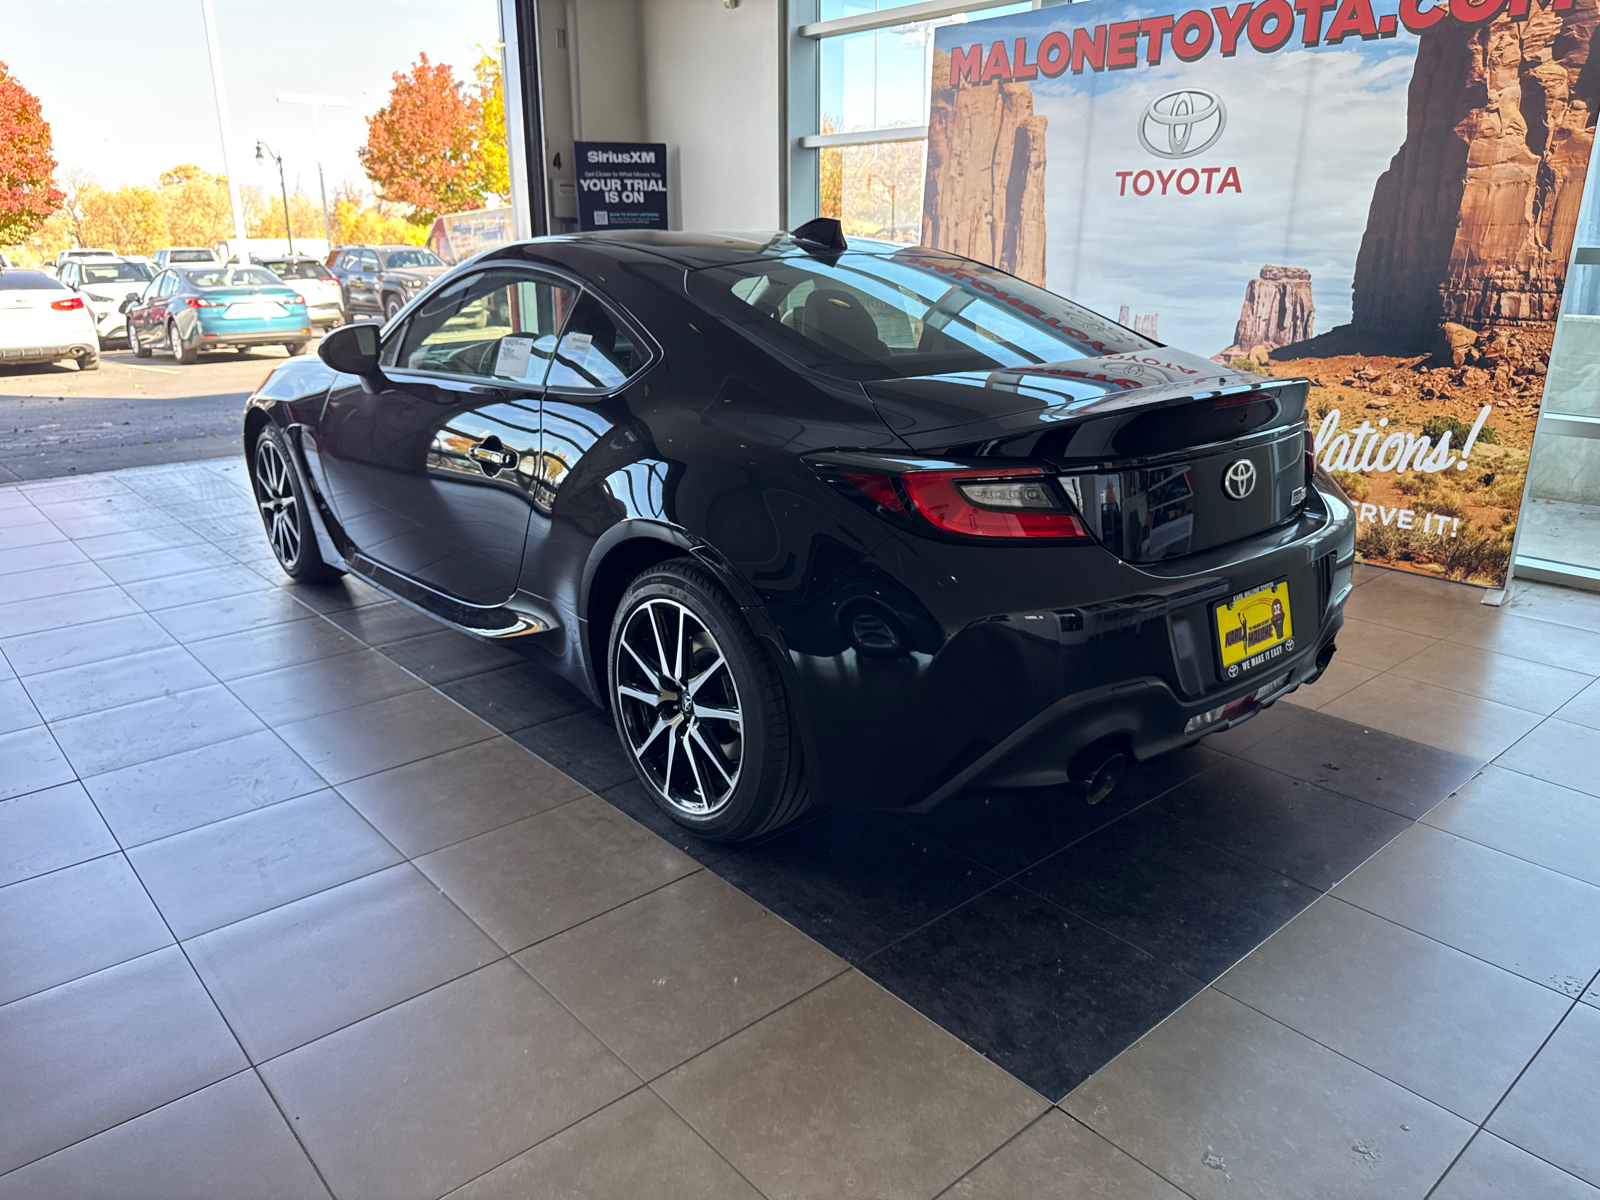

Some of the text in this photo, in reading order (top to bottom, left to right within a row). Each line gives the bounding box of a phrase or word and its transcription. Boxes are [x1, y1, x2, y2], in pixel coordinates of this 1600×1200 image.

[588, 151, 656, 163] SiriusXM
[580, 179, 667, 192] YOUR TRIAL
[1115, 166, 1242, 196] TOYOTA
[605, 191, 644, 203] IS ON
[1423, 513, 1460, 538] IT!
[1273, 603, 1281, 615] 32
[1242, 645, 1283, 671] WE MAKE IT EASY
